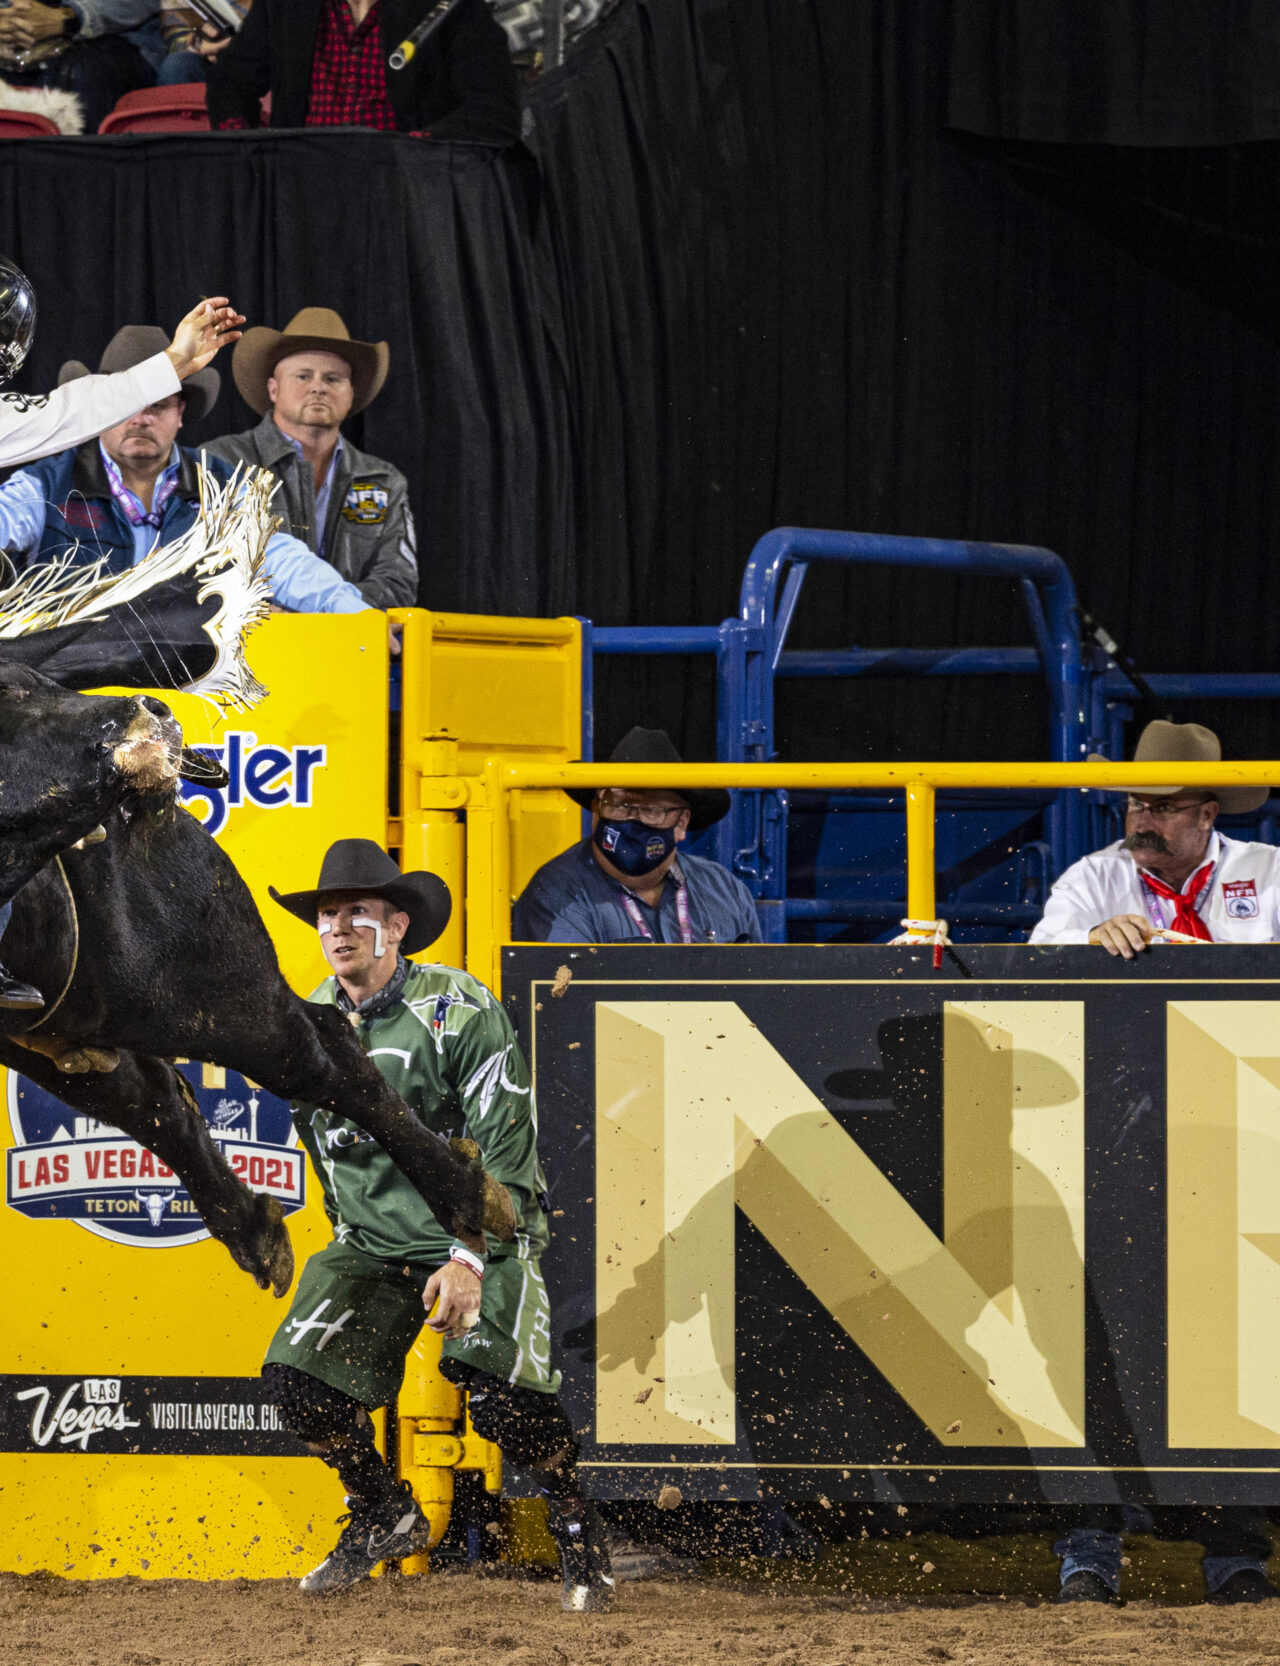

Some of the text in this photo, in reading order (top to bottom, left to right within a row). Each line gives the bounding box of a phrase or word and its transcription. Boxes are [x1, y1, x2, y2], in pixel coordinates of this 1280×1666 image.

[344, 490, 389, 508] NFR
[1225, 888, 1255, 898] NFR
[18, 1148, 296, 1191] LAS VEGAS 2021
[85, 1198, 140, 1213] TETON
[88, 1382, 118, 1401] LAS
[17, 1382, 140, 1450] Vegas
